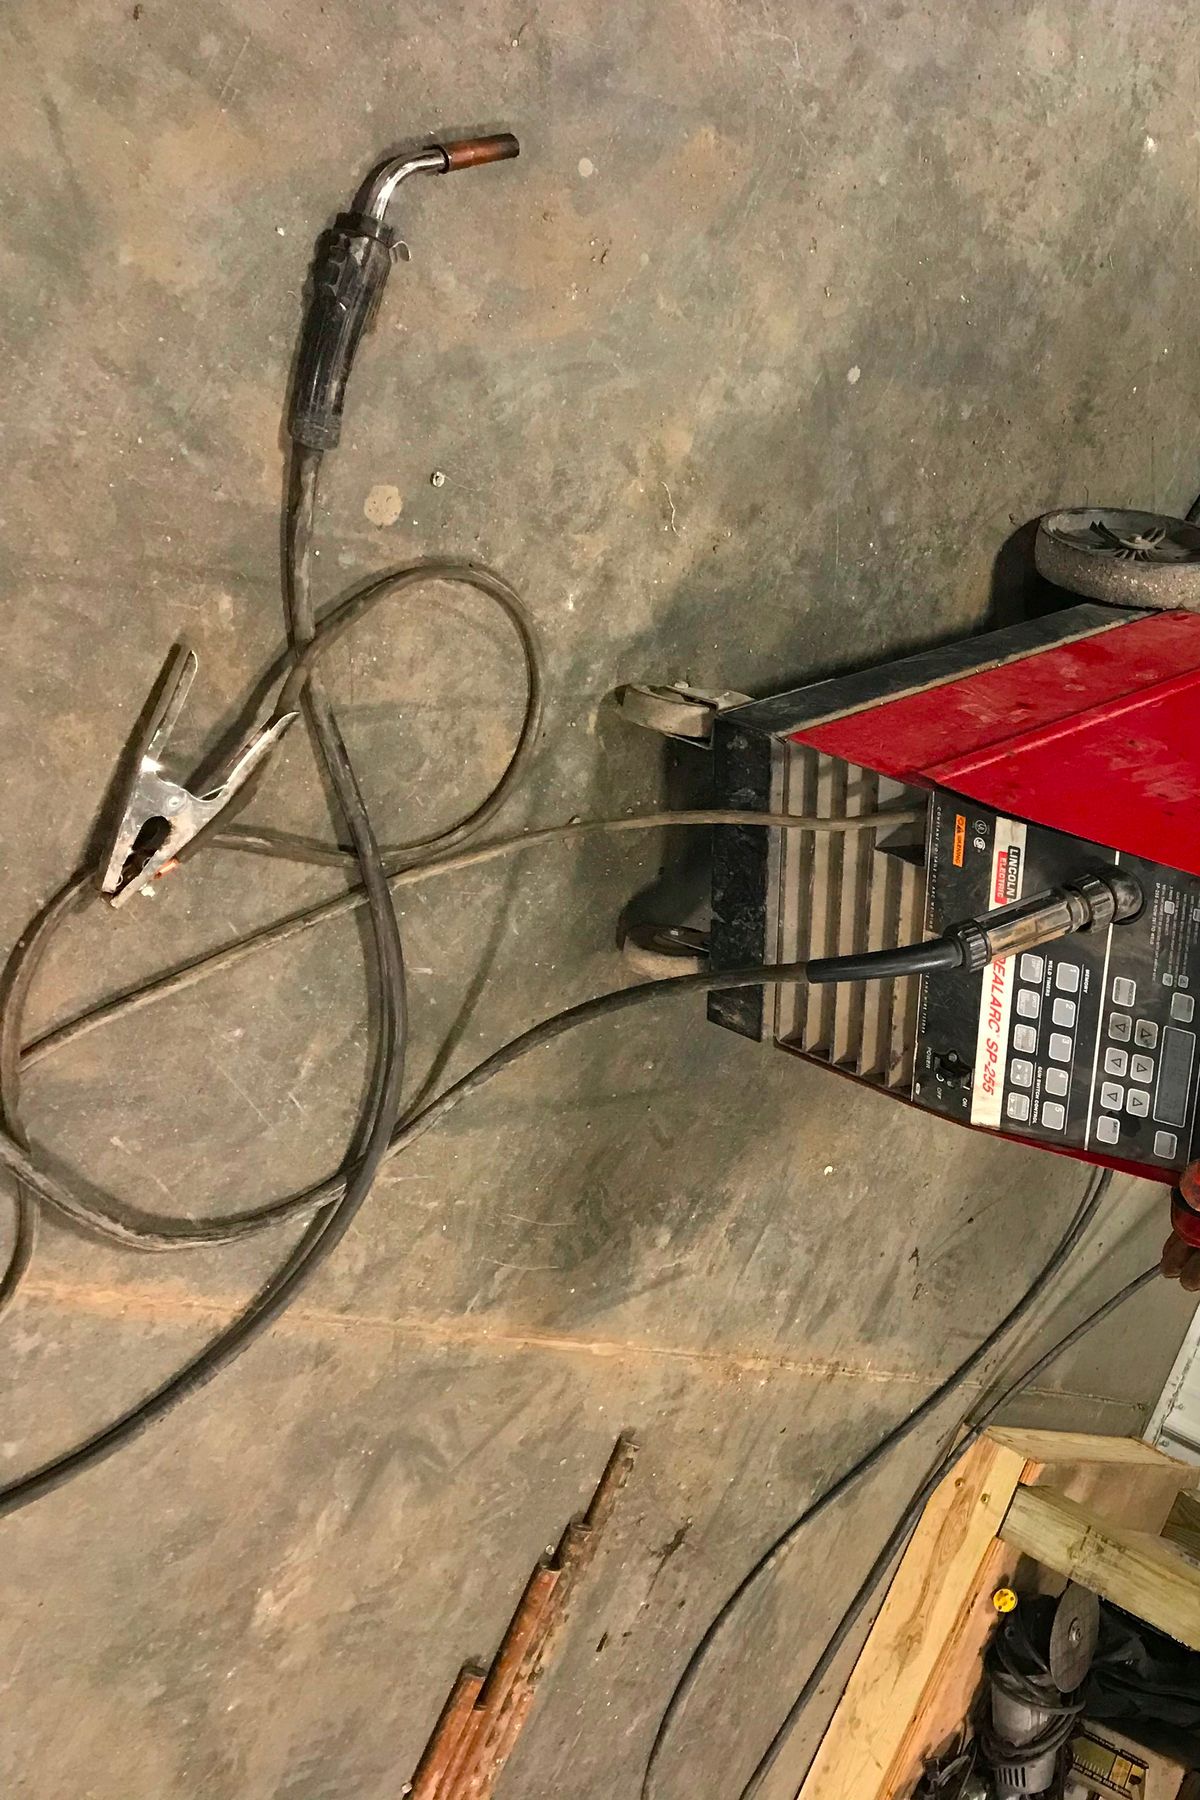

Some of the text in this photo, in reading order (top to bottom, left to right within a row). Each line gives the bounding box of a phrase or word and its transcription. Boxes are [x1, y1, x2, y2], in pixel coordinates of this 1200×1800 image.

[997, 857, 1007, 899] ELECTRIC
[1006, 848, 1018, 897] LINCOLN
[982, 1037, 999, 1096] SP-255
[962, 1097, 968, 1108] ON
[1032, 1100, 1040, 1124] CONTROL
